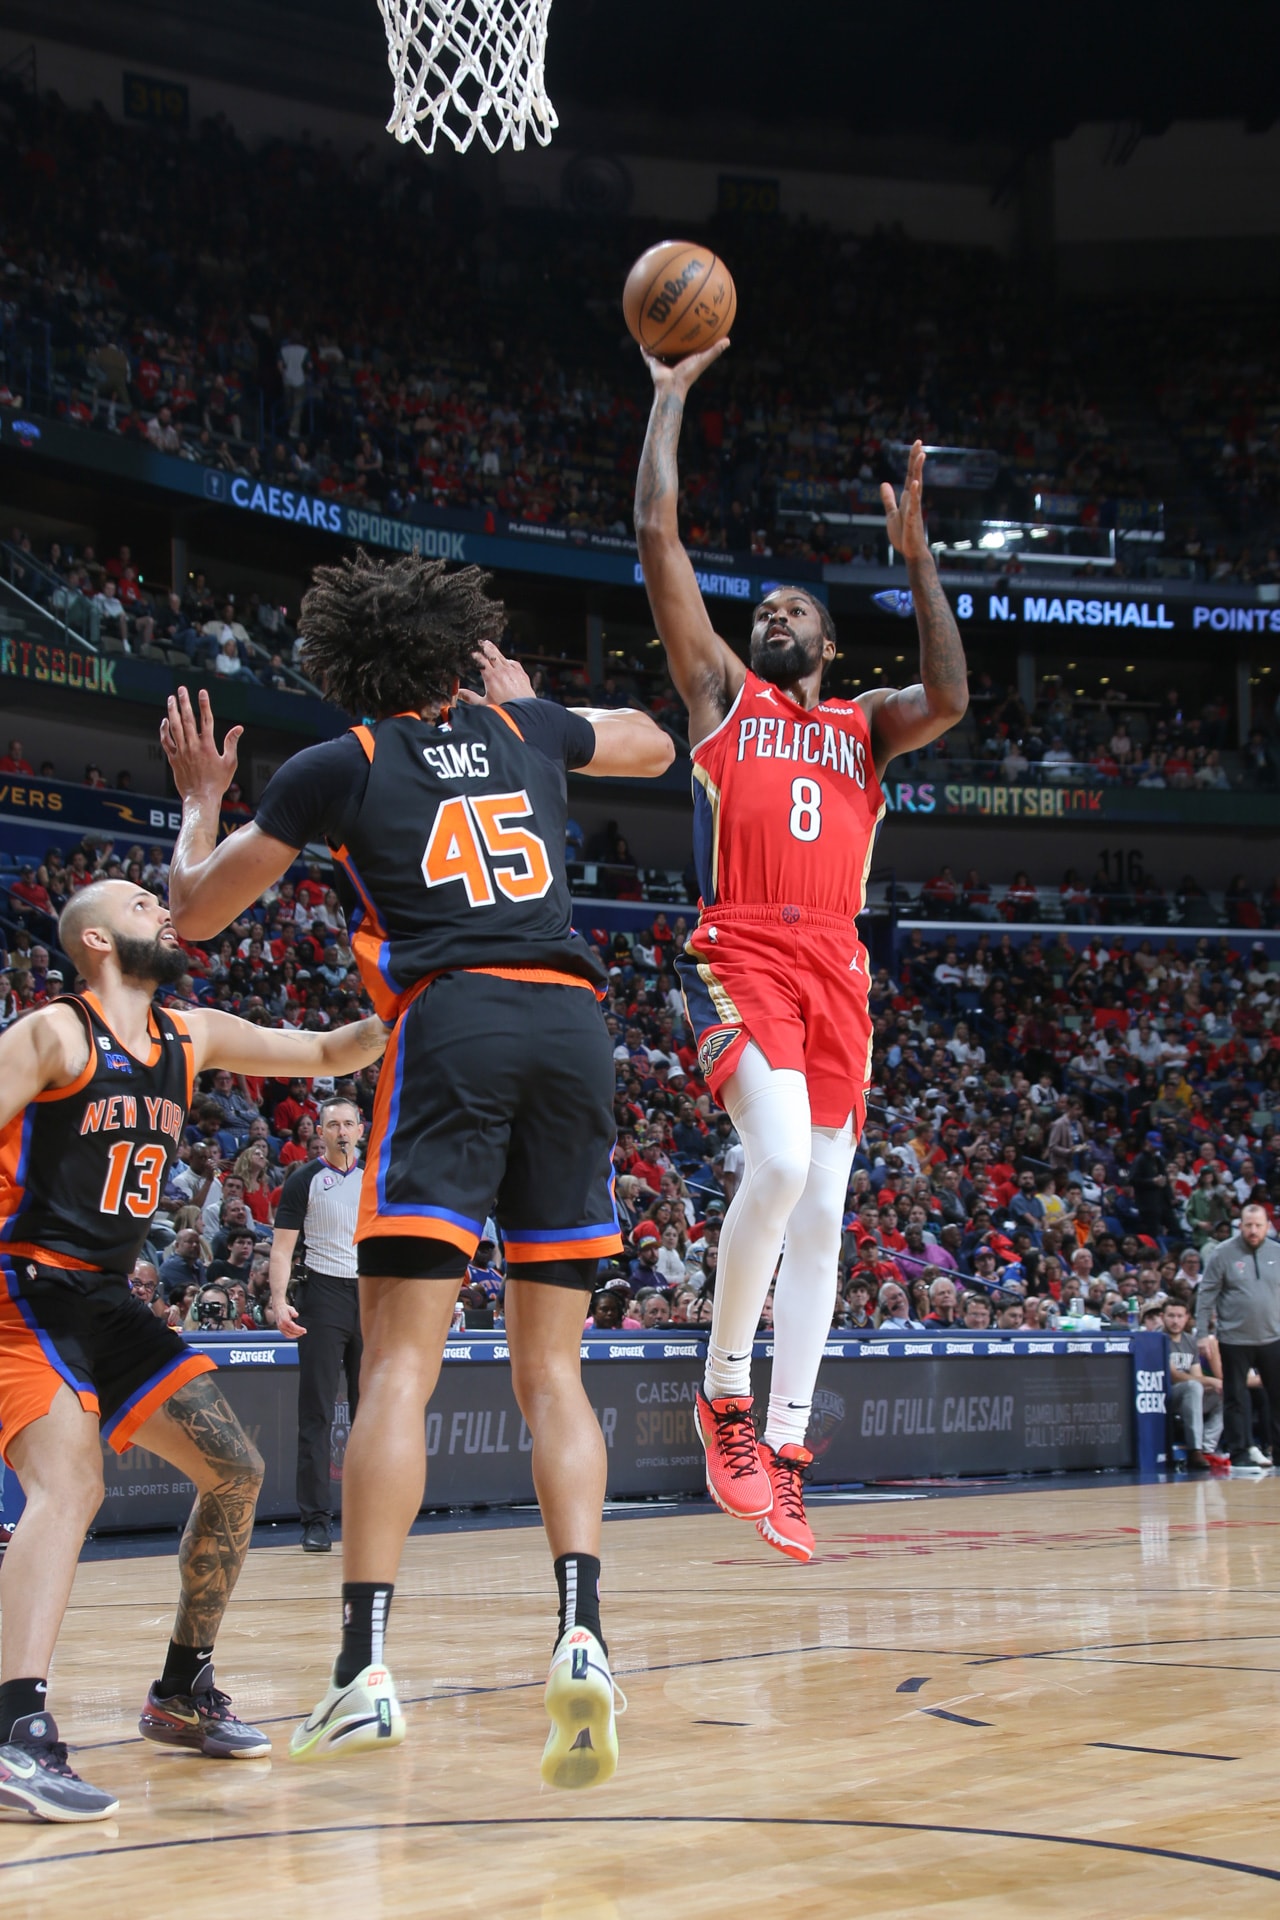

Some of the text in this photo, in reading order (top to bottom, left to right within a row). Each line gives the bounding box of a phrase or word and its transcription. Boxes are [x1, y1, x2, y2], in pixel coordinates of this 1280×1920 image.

[130, 80, 183, 117] 319
[721, 182, 776, 214] 320
[647, 259, 704, 324] Wilson
[231, 478, 466, 560] CAESARS SPORTSBOOK
[957, 594, 1280, 632] 8 N. MARSHALL POINTS
[423, 743, 490, 779] SIMS
[737, 717, 866, 790] PELICANS
[788, 777, 822, 842] 8
[421, 789, 554, 908] 45
[1098, 848, 1143, 882] 116
[97, 1036, 112, 1051] 6
[80, 1095, 185, 1148] NEW YOR
[99, 1140, 168, 1219] 13
[229, 1349, 276, 1364] SEATGEEK
[609, 1345, 645, 1358] SEATGEEK
[663, 1344, 698, 1357] SEATGEEK
[859, 1344, 889, 1357] SEATGEEK
[904, 1343, 933, 1356] SEATGEEK
[946, 1343, 974, 1355] SEATGEEK
[988, 1343, 1015, 1355] SEATGEEK
[1136, 1370, 1165, 1392] SEAT
[861, 1394, 1015, 1437] GO FULL CAESAR
[1136, 1392, 1167, 1414] GEEK
[448, 1411, 510, 1455] FULL
[636, 1456, 669, 1468] OFFICIAL
[128, 1483, 170, 1497] SPORTS
[367, 1671, 387, 1687] GT
